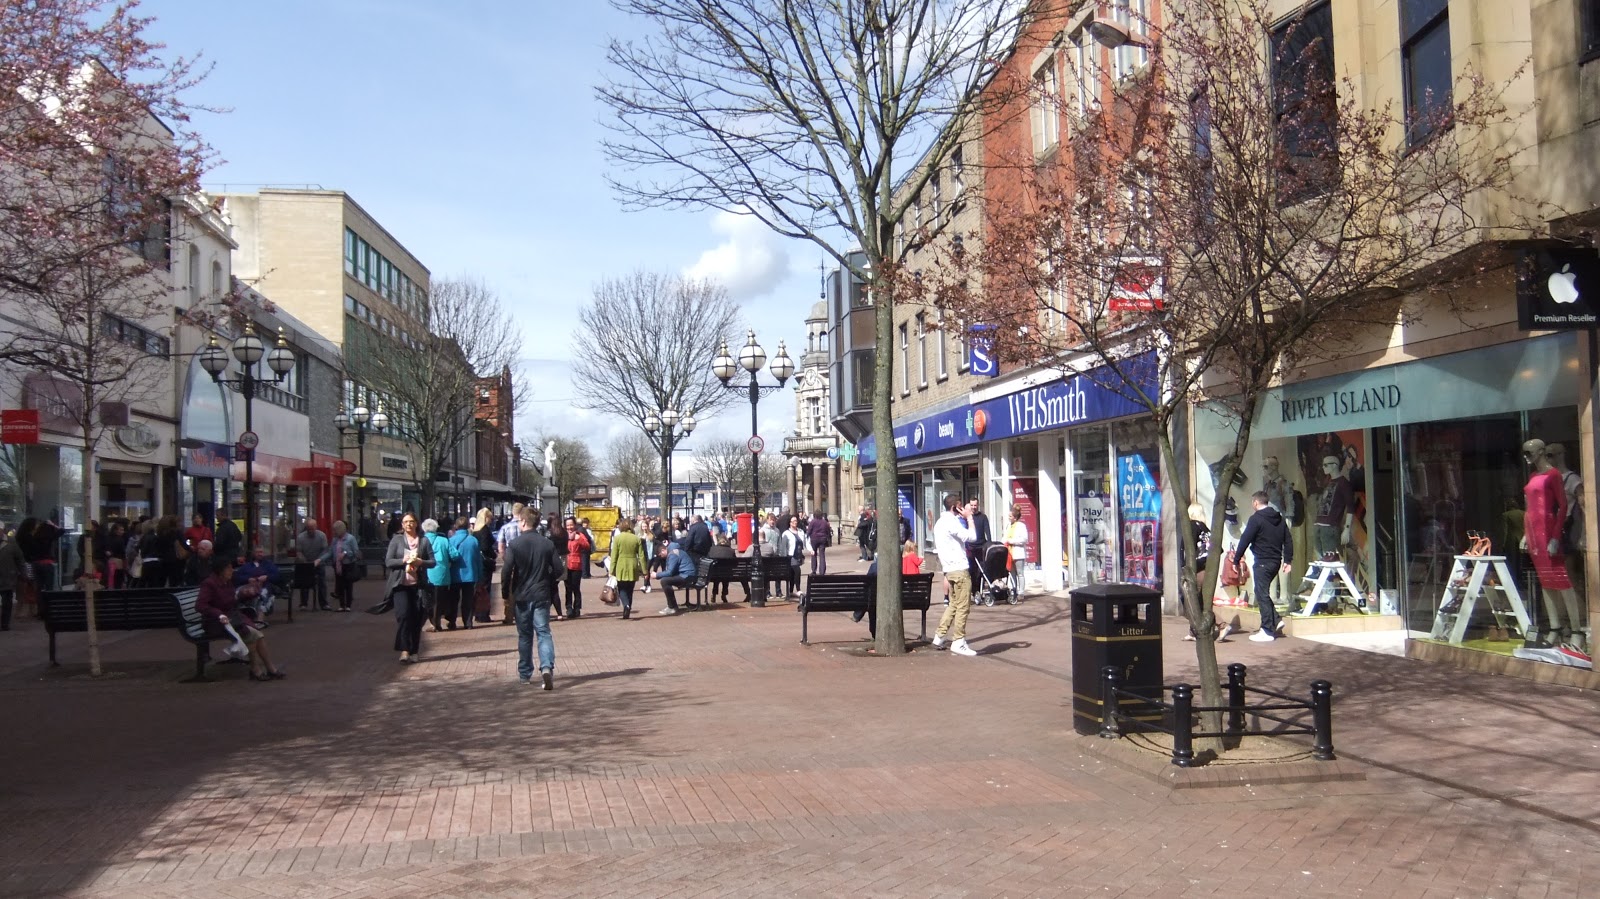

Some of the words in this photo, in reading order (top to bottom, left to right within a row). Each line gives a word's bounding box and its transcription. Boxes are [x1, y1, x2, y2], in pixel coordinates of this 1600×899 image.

[1534, 314, 1567, 322] Premium
[1568, 314, 1597, 322] Reseller
[1008, 375, 1087, 434] WHSmith
[1281, 396, 1327, 423] RIVER
[1333, 384, 1401, 416] ISLAND
[938, 419, 954, 438] beauty
[1126, 457, 1134, 481] 3
[1082, 507, 1102, 517] Play
[1121, 627, 1144, 636] Litter
